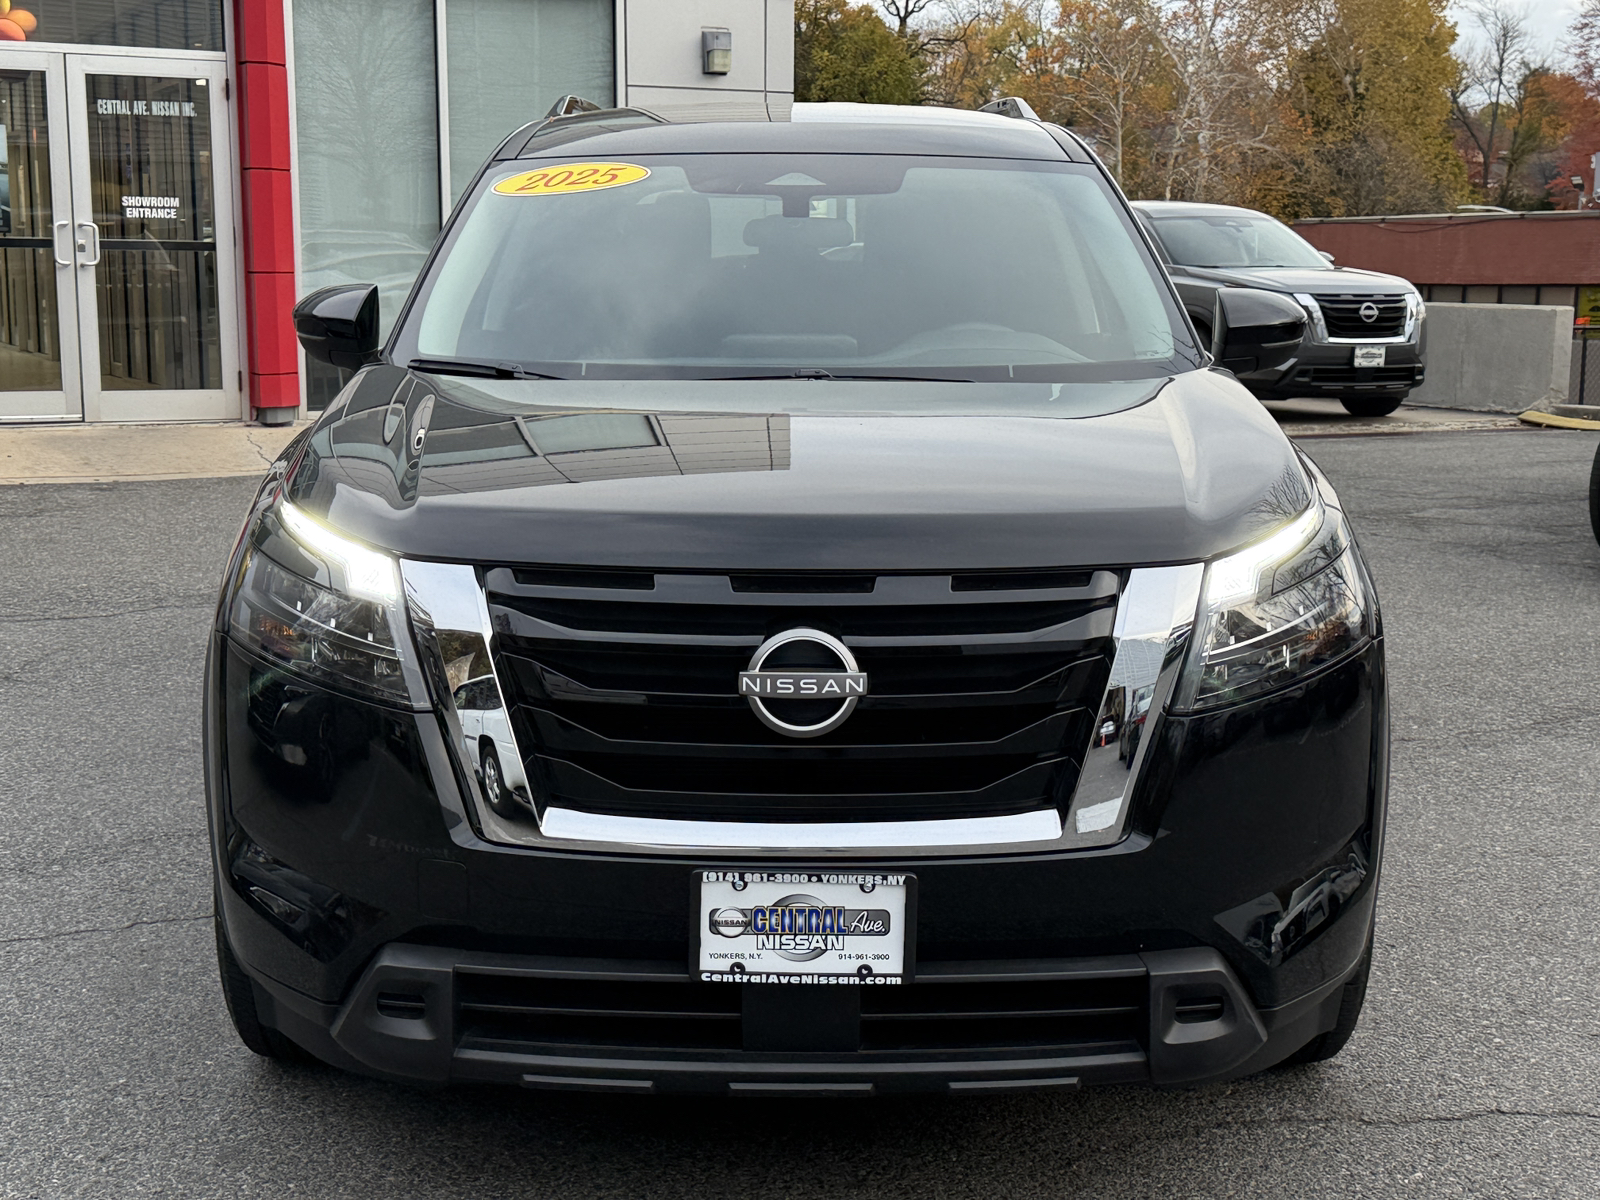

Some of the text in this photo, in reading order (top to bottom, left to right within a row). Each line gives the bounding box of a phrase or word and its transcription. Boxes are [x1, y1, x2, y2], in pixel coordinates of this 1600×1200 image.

[97, 99, 197, 117] CENTRAL AVE. NISSAN INC.
[515, 167, 628, 192] 2025
[121, 196, 180, 208] SHOWROOM
[126, 208, 178, 219] ENTRANCE
[741, 676, 864, 694] NISSAN
[751, 905, 886, 935] CENTRAL Ave.
[756, 934, 845, 951] NISSAN
[709, 953, 747, 961] YONKERS,
[838, 953, 890, 961] 914-961-3900
[701, 973, 902, 985] CentralAveNissan.com
